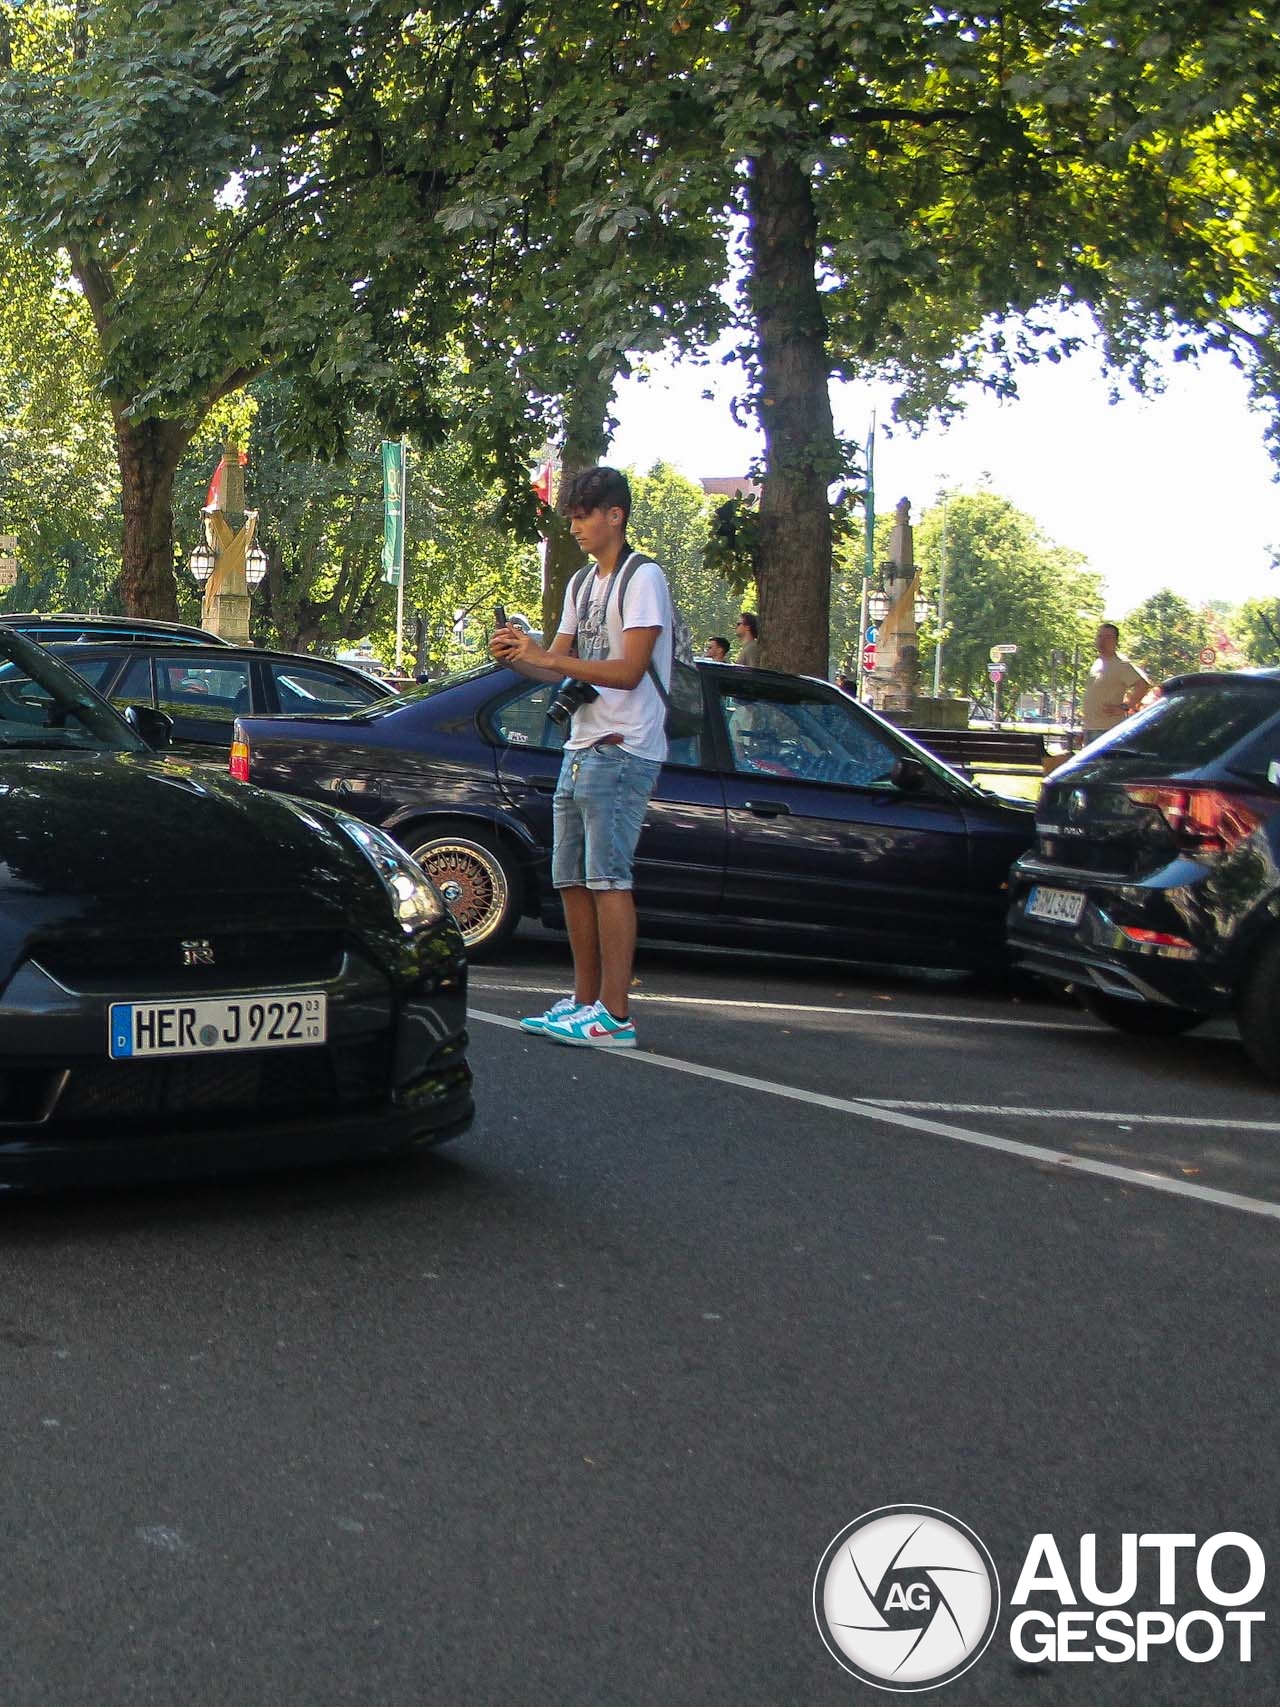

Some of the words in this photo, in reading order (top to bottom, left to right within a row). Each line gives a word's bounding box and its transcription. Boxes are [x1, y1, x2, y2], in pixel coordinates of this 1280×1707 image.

[305, 1000, 320, 1011] 03
[136, 1008, 197, 1049] HER
[223, 1006, 241, 1042] J
[248, 1002, 303, 1041] 922
[306, 1025, 319, 1037] 10
[118, 1036, 126, 1047] D
